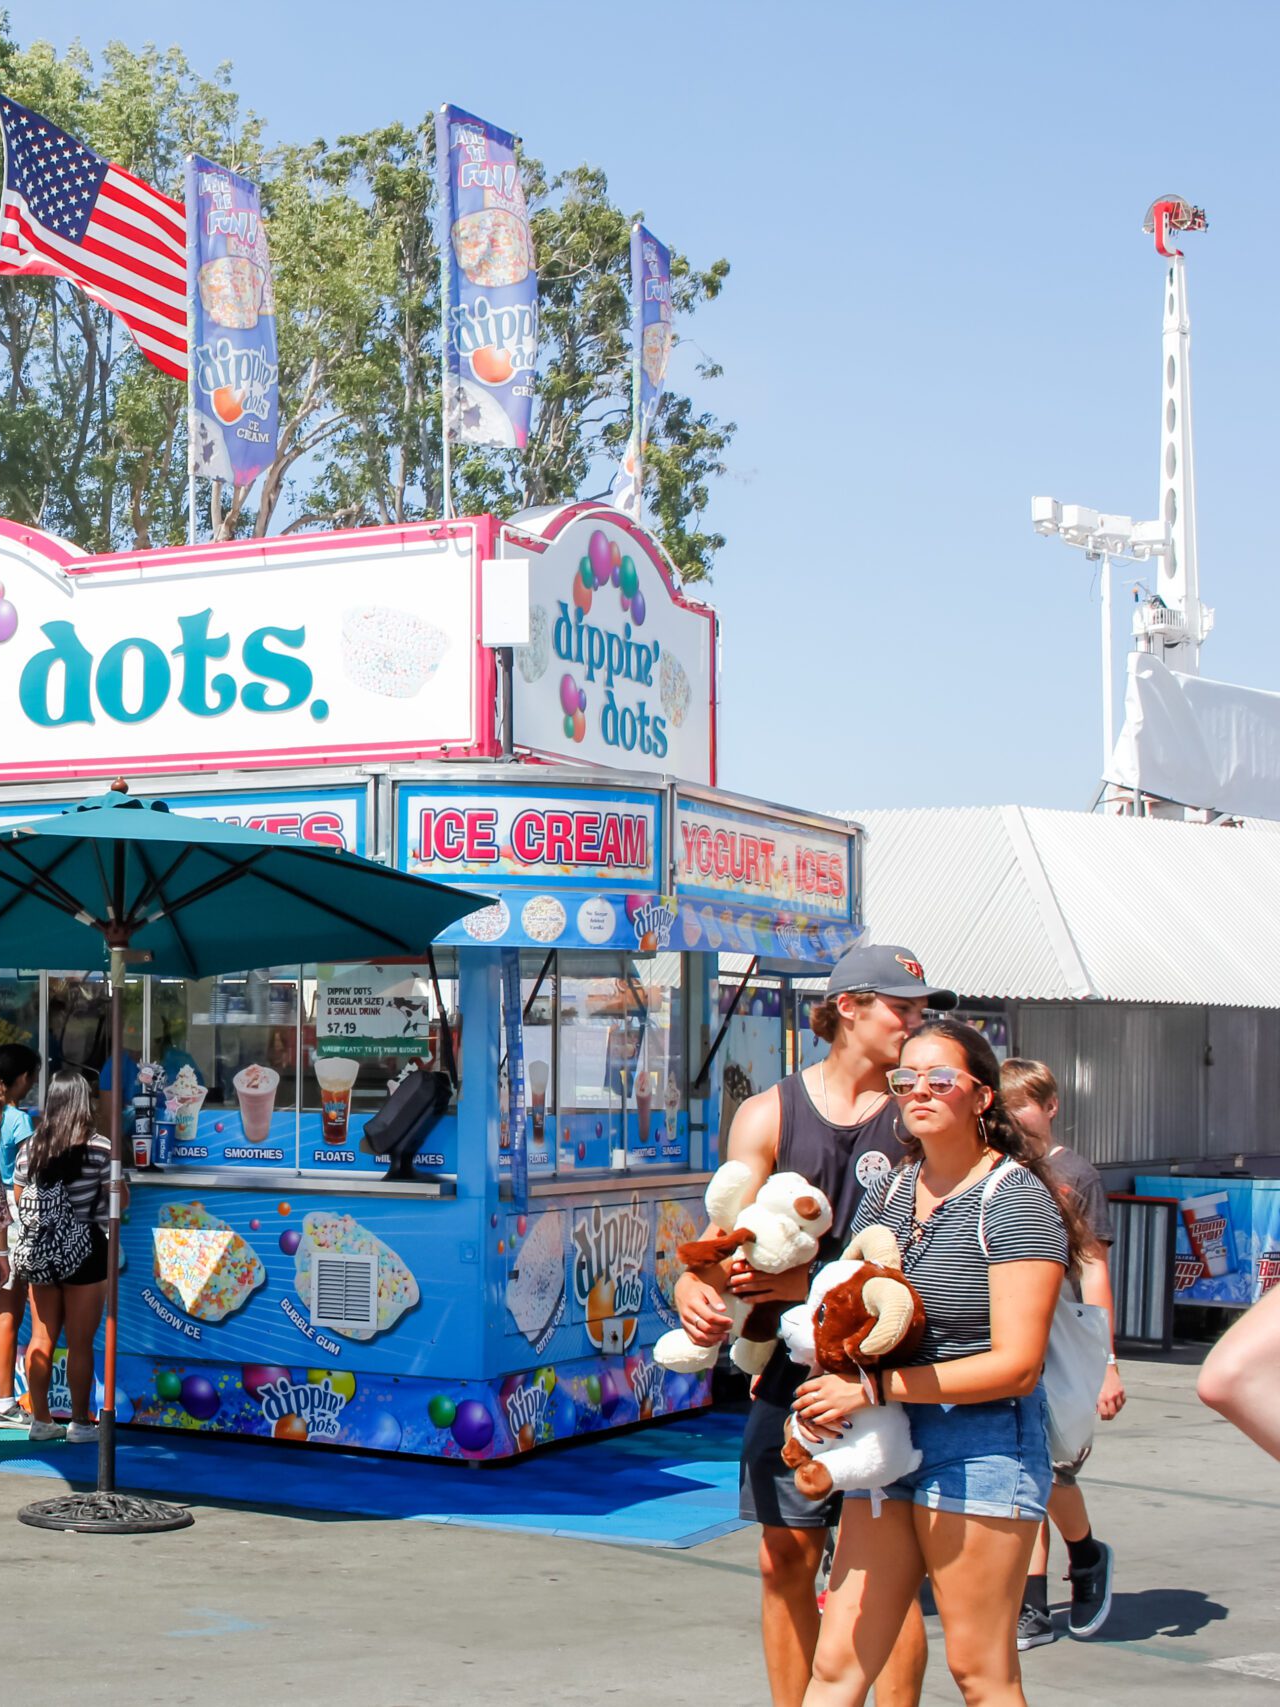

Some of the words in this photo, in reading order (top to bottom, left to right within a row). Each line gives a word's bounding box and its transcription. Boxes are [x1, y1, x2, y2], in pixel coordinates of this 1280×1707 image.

[206, 210, 258, 244] FUN!
[553, 599, 661, 689] dippin'
[600, 688, 669, 760] dots
[417, 806, 499, 865] ICE
[509, 808, 651, 871] CREAM
[679, 820, 776, 889] YOGURT
[793, 844, 846, 900] ICES
[327, 987, 352, 996] DIPPIN'
[353, 987, 373, 996] DOTS
[327, 996, 364, 1006] (REGULAR
[364, 997, 385, 1006] SIZE)
[327, 1021, 357, 1035] $7.19
[334, 1007, 357, 1016] SMALL
[358, 1007, 381, 1016] DRINK
[174, 1146, 208, 1157] NDAES
[224, 1147, 284, 1161] SMOOTHIES
[314, 1150, 356, 1164] FLOATS
[375, 1153, 445, 1166] MILAKES
[528, 1152, 549, 1165] FLOATS
[573, 1191, 649, 1299] dippin'
[615, 1270, 643, 1315] dots
[140, 1288, 185, 1333] RAINBOW
[182, 1322, 202, 1341] ICE
[279, 1297, 318, 1343] BUBBLE
[315, 1331, 342, 1357] GUM
[535, 1320, 555, 1355] COTTON
[256, 1376, 346, 1423] dippin'
[306, 1413, 341, 1439] dots
